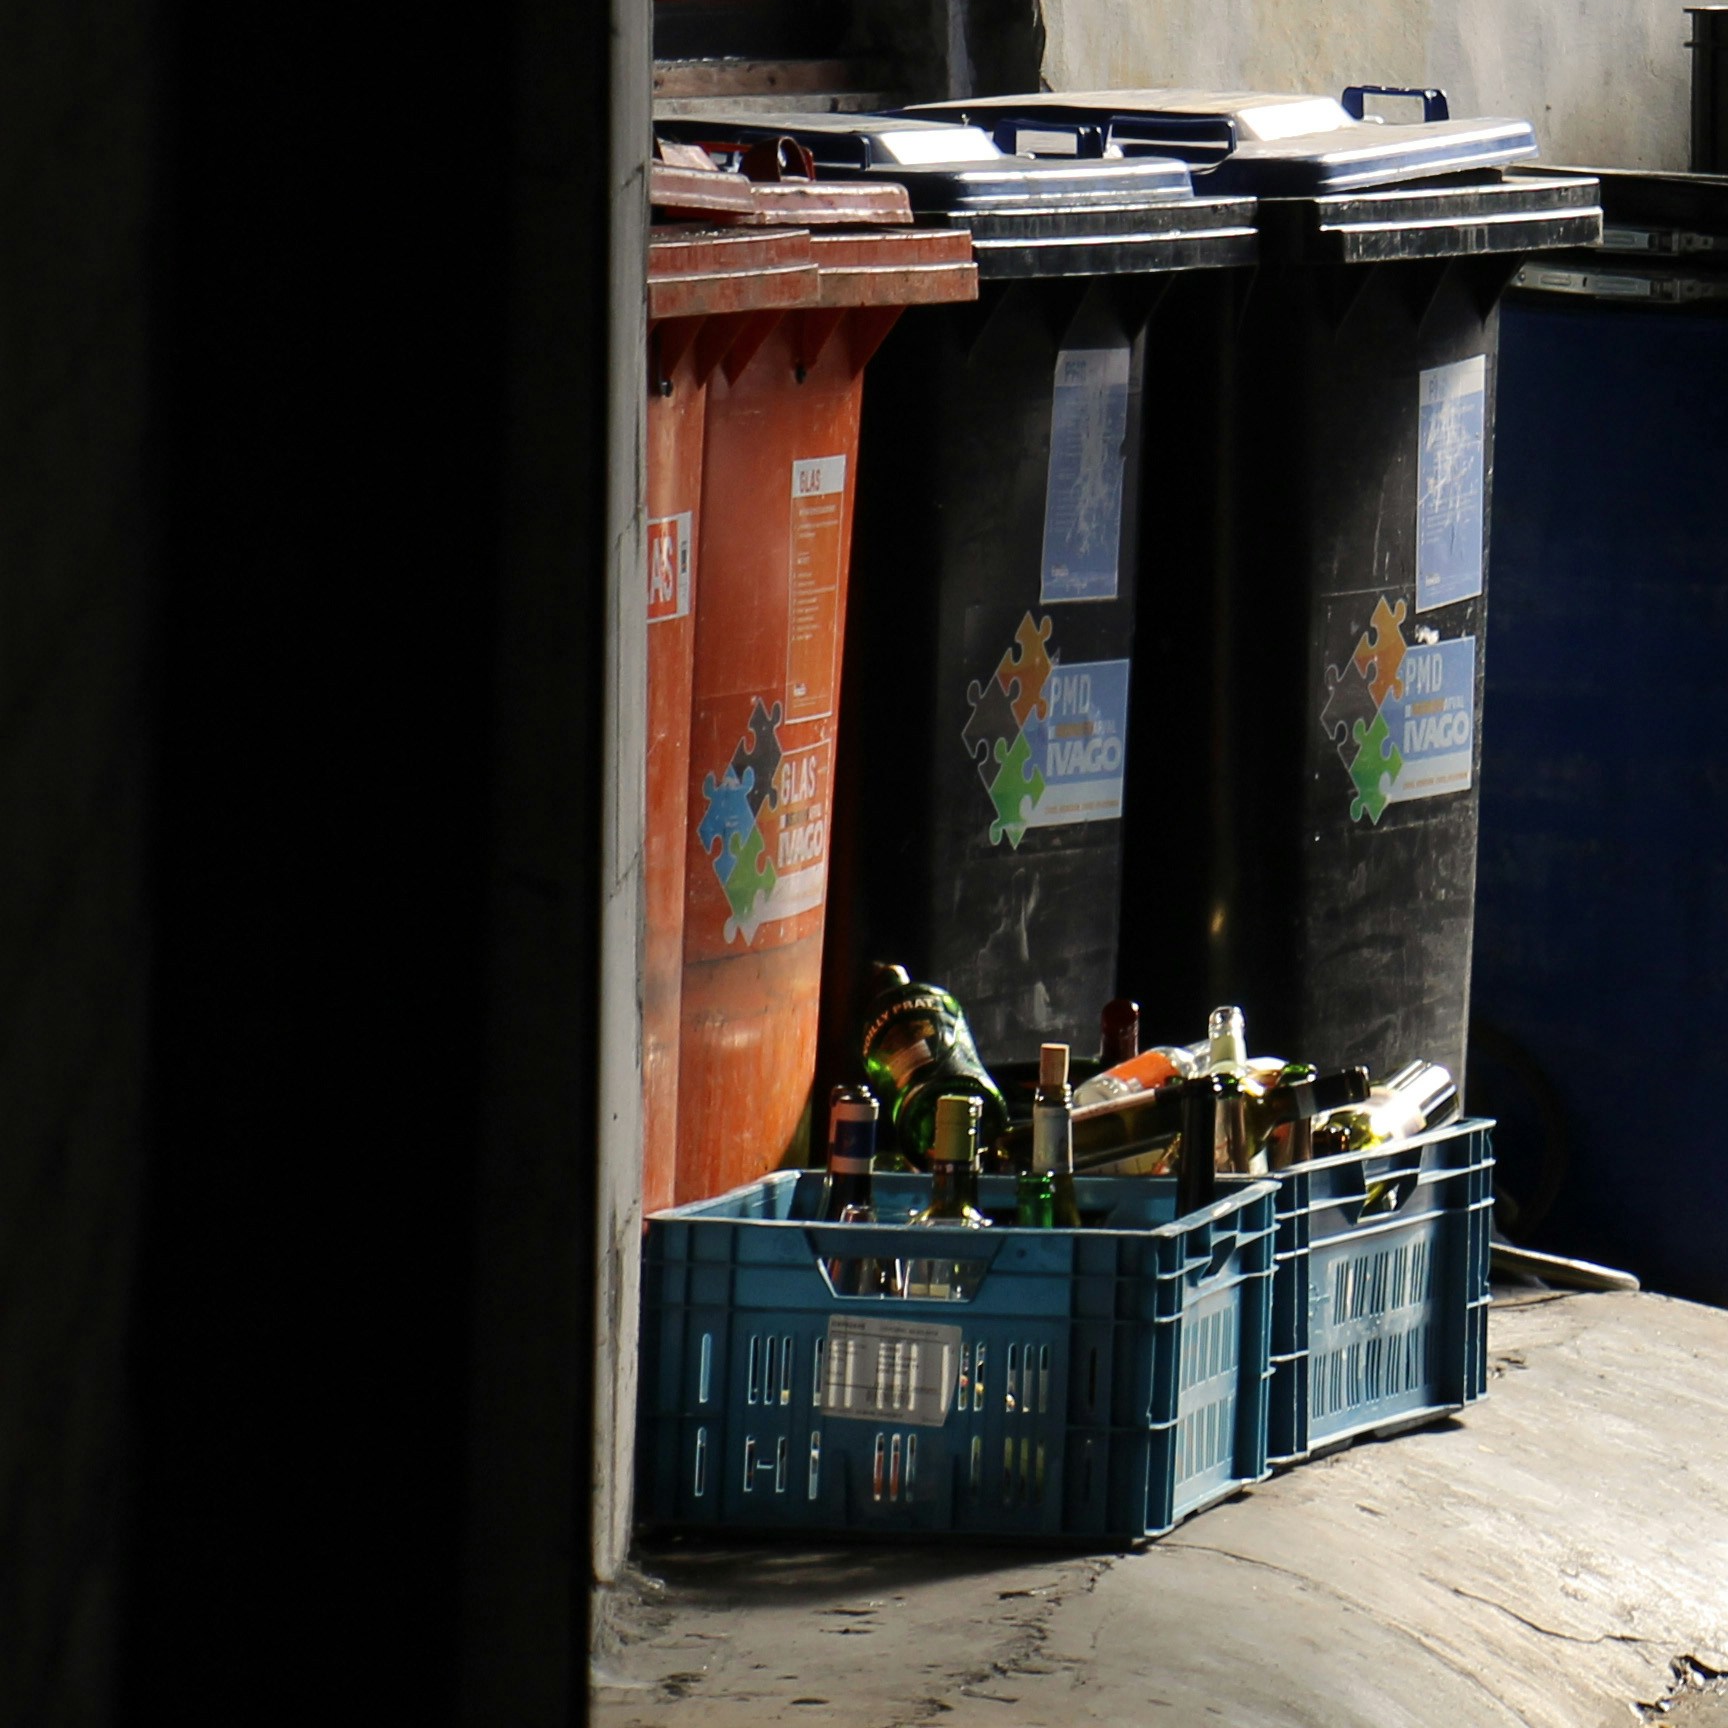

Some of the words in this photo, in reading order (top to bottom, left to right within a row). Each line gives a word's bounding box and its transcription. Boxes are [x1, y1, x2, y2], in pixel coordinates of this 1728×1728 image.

[1049, 673, 1091, 718] PMD
[1404, 652, 1443, 697] PMD
[780, 754, 818, 806] GLAS
